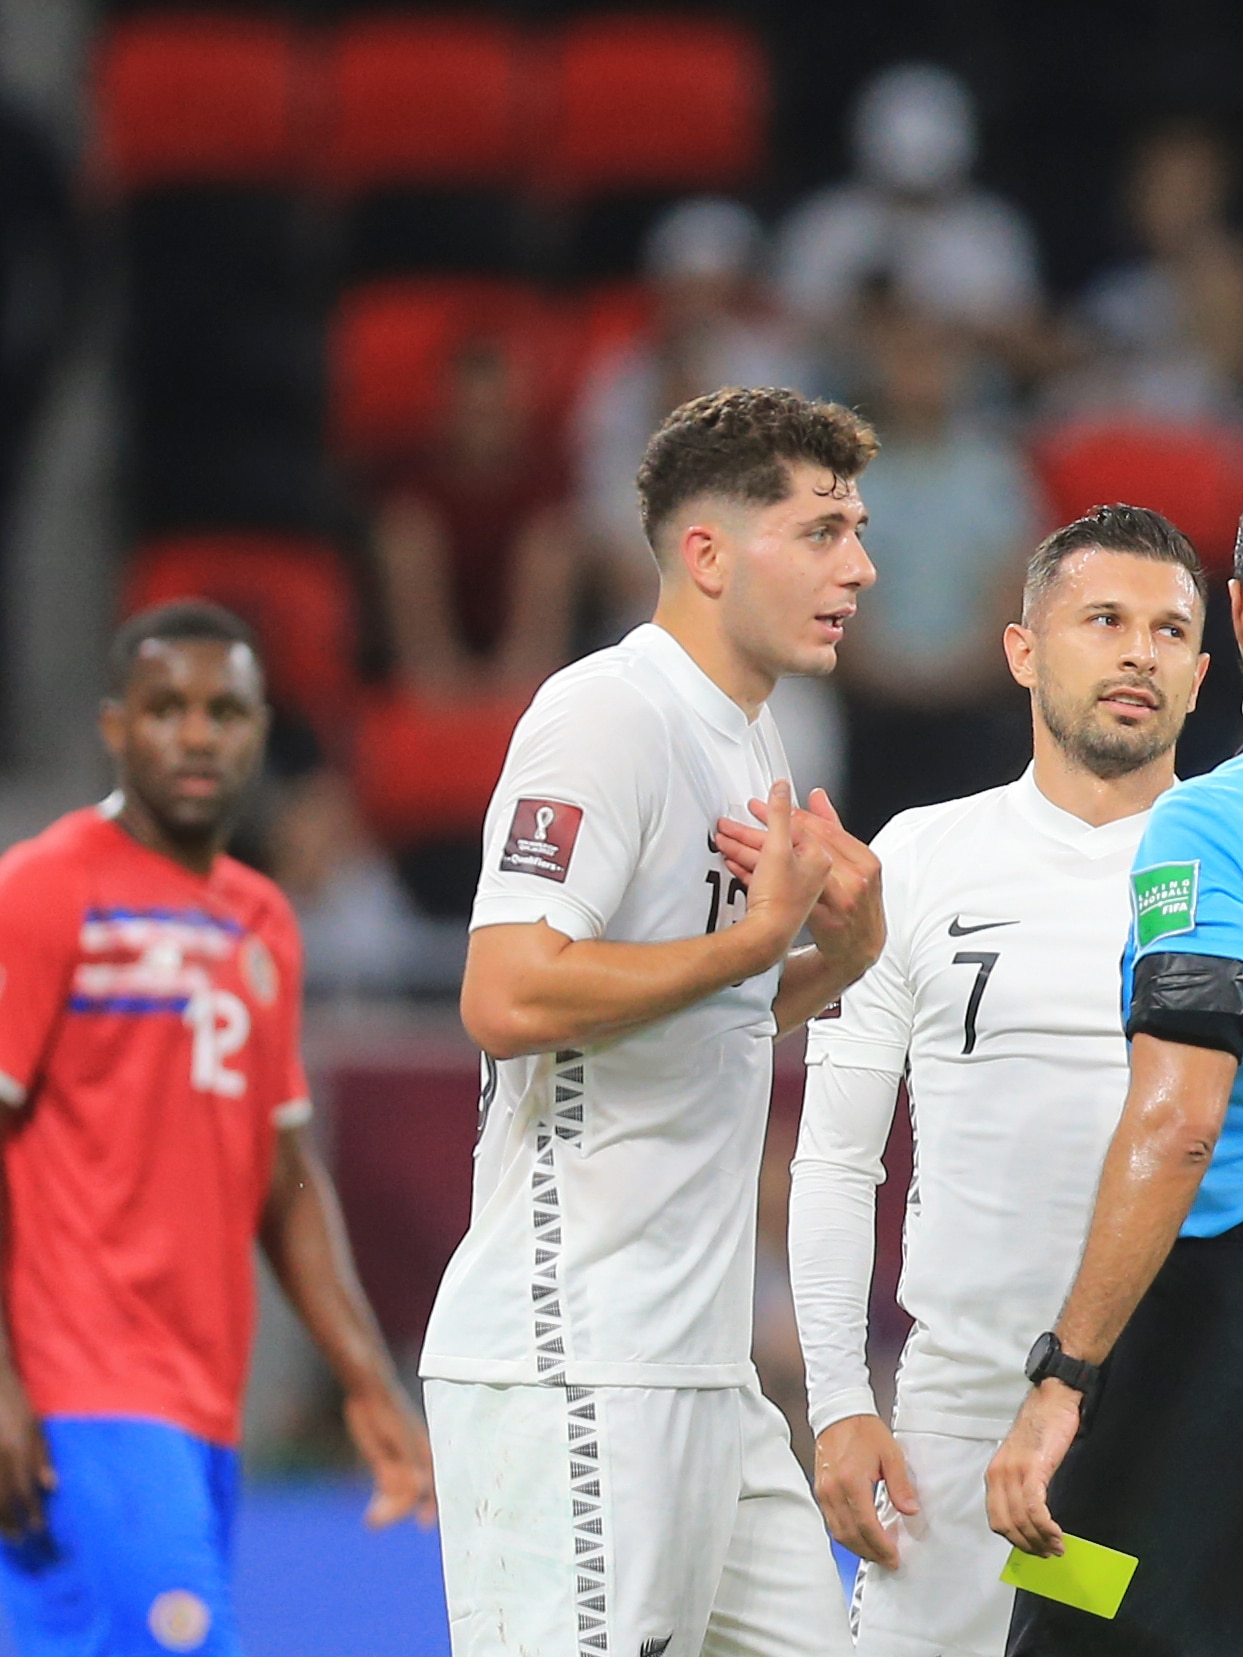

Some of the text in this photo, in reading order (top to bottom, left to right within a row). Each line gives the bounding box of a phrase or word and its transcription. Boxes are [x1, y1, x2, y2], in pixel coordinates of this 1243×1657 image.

[1139, 879, 1190, 902] LIVING
[1139, 887, 1189, 911] FOOTBALL
[1162, 902, 1188, 915] FIFA
[951, 952, 1000, 1055] 7
[182, 980, 250, 1098] 12
